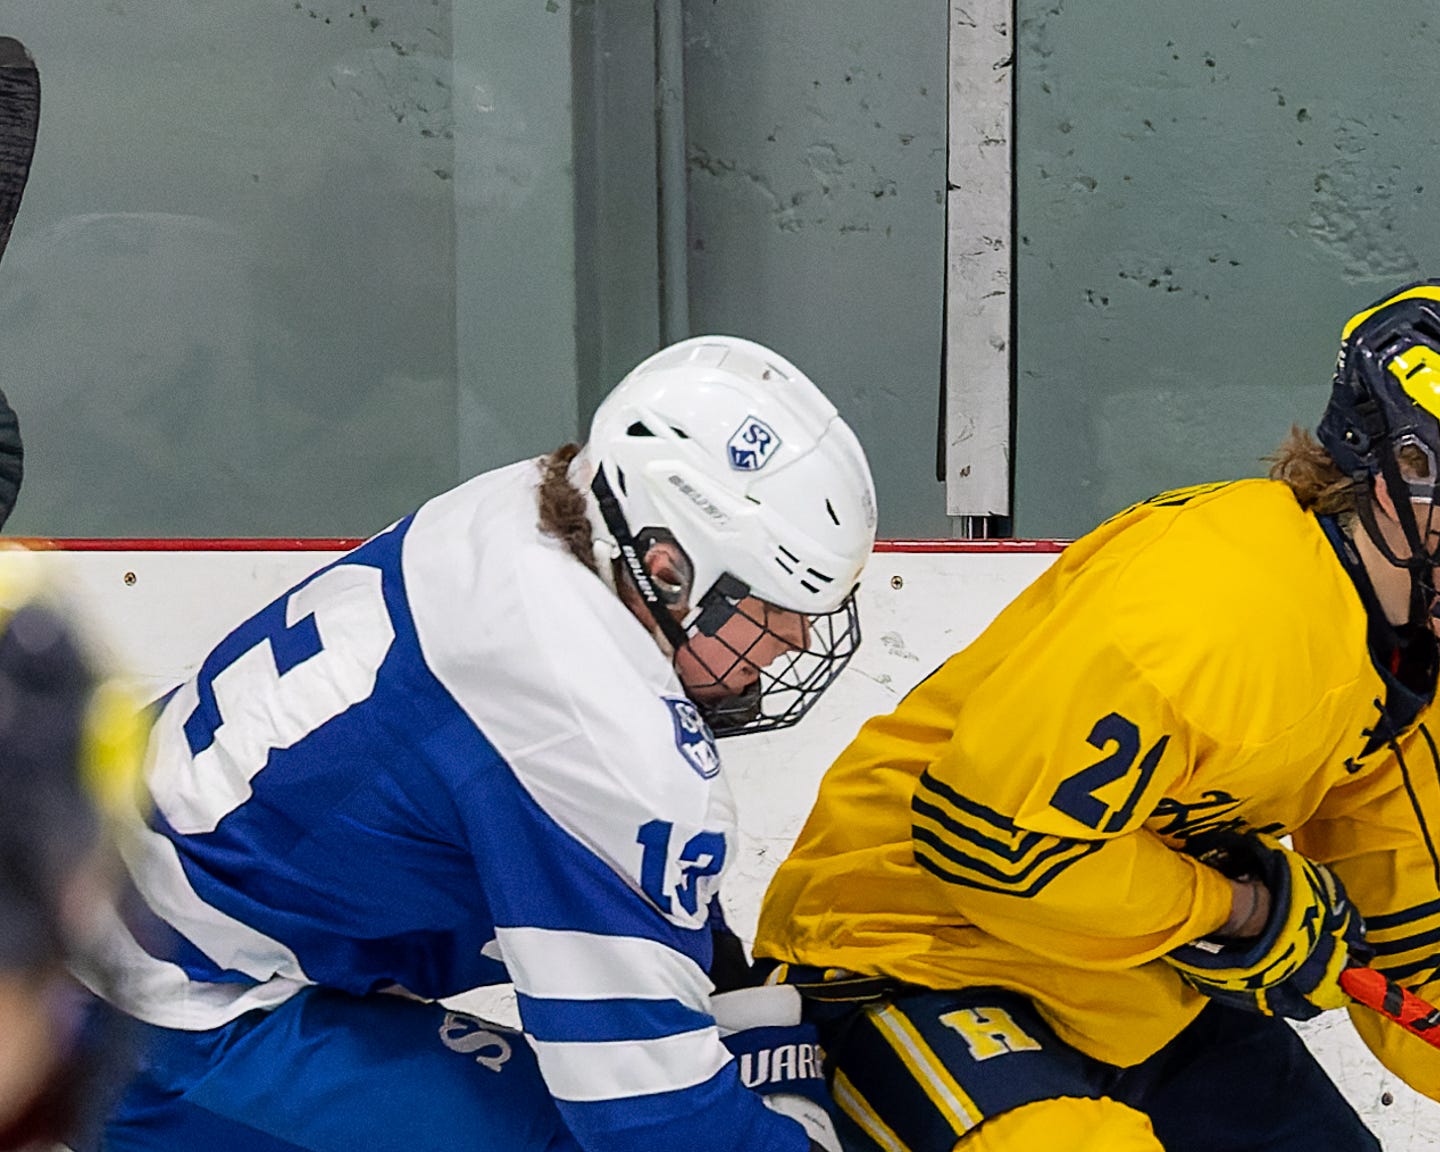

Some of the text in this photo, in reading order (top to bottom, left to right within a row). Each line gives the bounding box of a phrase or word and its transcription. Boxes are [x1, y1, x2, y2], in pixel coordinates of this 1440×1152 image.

[1049, 712, 1172, 833] 21
[636, 818, 727, 916] 13
[939, 1007, 1043, 1062] H
